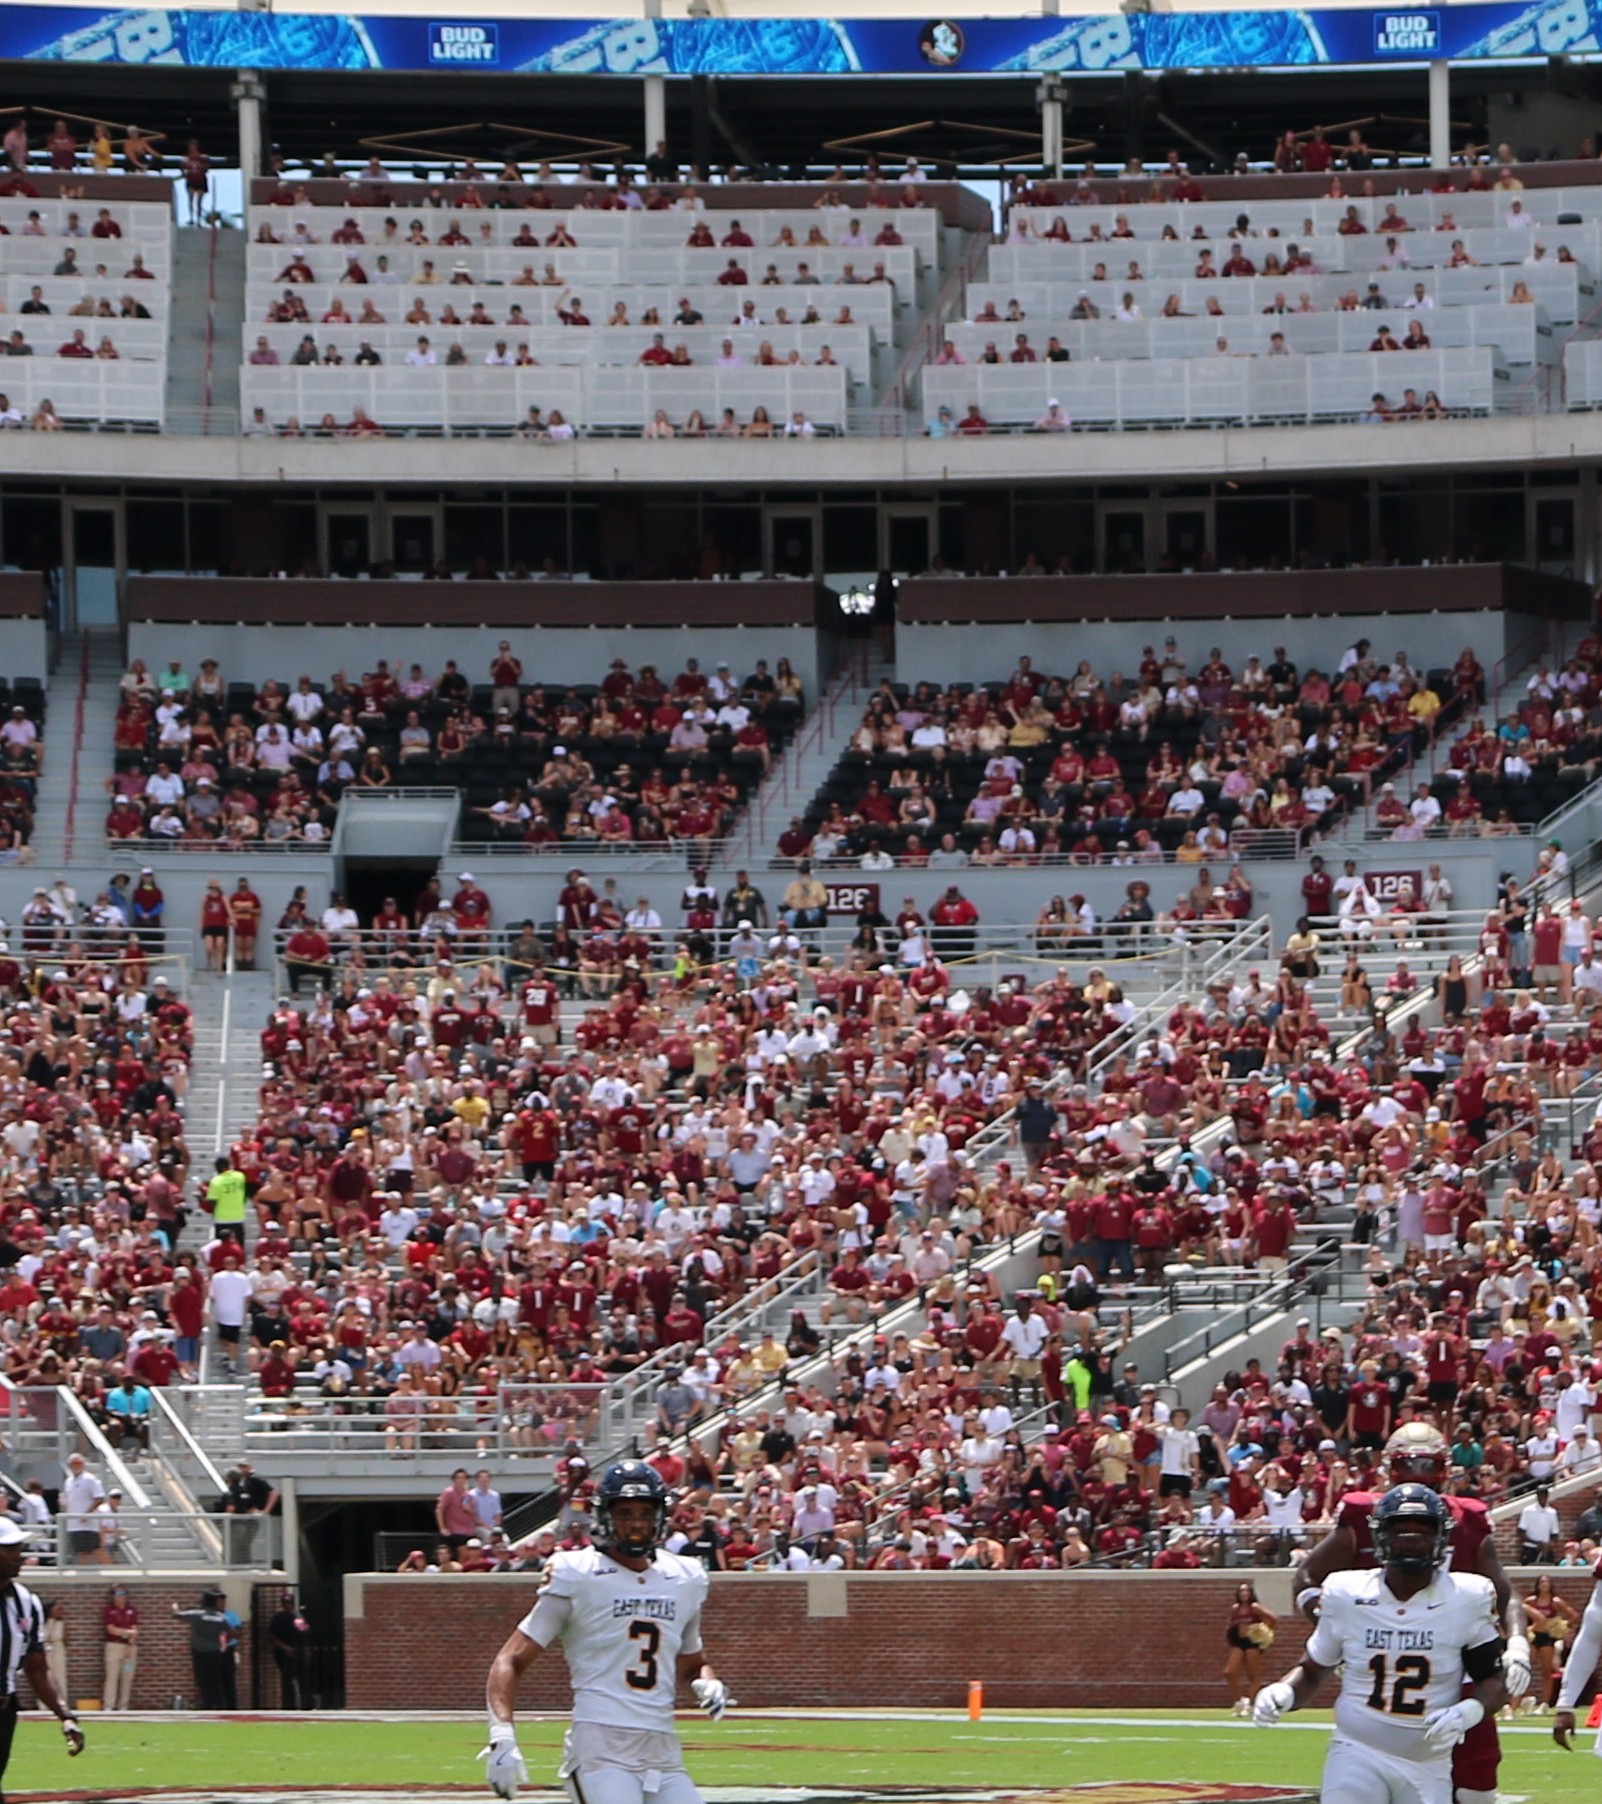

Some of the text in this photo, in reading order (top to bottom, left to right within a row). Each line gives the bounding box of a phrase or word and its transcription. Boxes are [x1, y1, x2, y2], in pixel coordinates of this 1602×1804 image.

[441, 26, 486, 42] BUD
[1385, 16, 1428, 32] BUD
[1377, 31, 1436, 49] LIGHT
[432, 42, 493, 59] LIGHT
[613, 1598, 676, 1621] EAST TEXAS
[1365, 1629, 1434, 1651] EAST TEXAS
[625, 1619, 662, 1691] 3
[1366, 1653, 1433, 1717] 12
